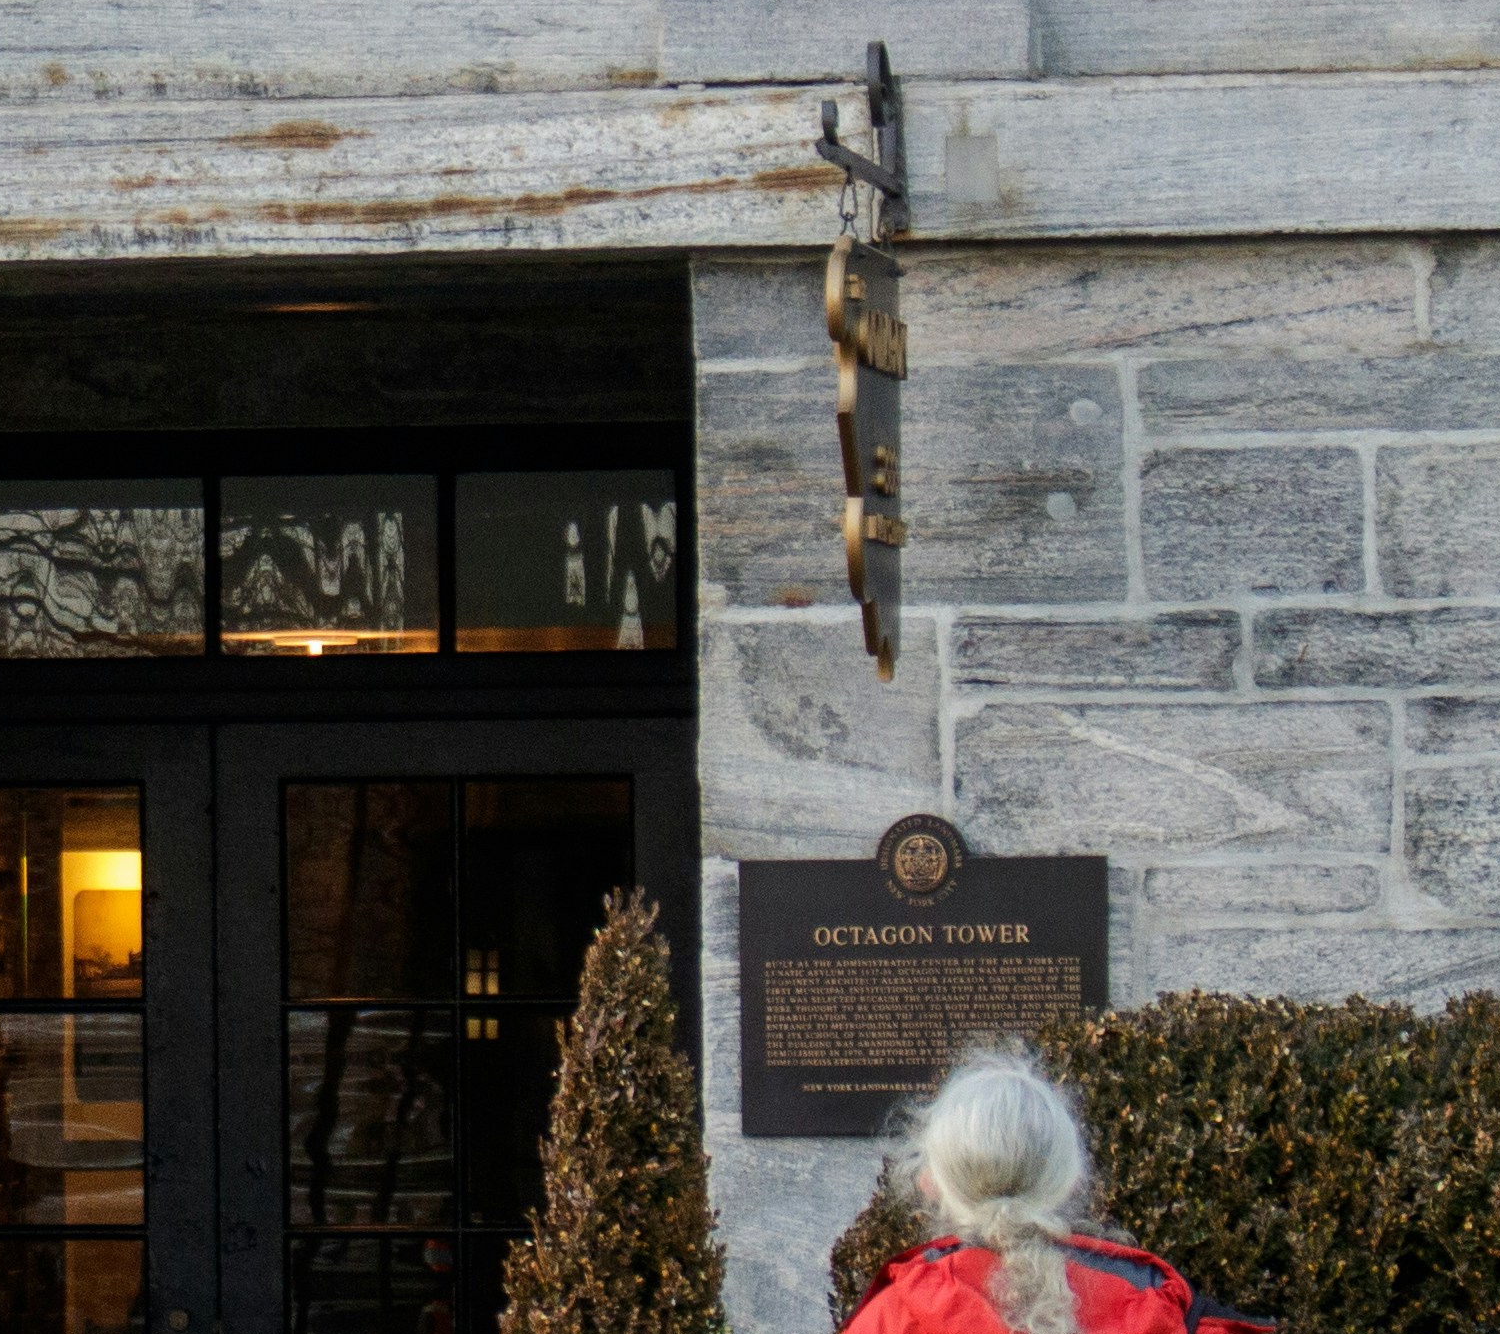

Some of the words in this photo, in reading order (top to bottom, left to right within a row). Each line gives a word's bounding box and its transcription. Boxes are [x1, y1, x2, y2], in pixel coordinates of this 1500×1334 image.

[814, 925, 934, 947] OCTAGON
[943, 923, 1031, 945] TOWER
[813, 959, 832, 968] THE
[836, 959, 917, 968] ADMINISTRATIVE
[922, 958, 959, 967] CENTER
[963, 958, 976, 966] OF
[980, 958, 998, 966] THE
[1002, 957, 1023, 966] NEW
[1027, 957, 1054, 966] YORK
[1057, 957, 1081, 965] CITY
[807, 968, 845, 977] ASYLUM
[847, 968, 857, 976] IN
[897, 967, 941, 976] OCTAGON
[944, 967, 975, 975] TOWER
[978, 967, 997, 975] WAS
[999, 966, 1046, 975] DESIGNED
[1063, 966, 1081, 974] THE
[824, 977, 878, 985] ARCHITECT
[881, 976, 938, 985] ALEXANDER
[942, 976, 985, 984] JACKSON
[1046, 975, 1058, 983] OF
[1063, 975, 1081, 983] THE
[765, 987, 791, 995] FIRST
[795, 986, 845, 995] MUNICIPAL
[849, 985, 914, 995] INSTITUTIONS
[917, 985, 928, 994] OF
[933, 985, 948, 994] ITS
[951, 985, 973, 994] TYPE
[978, 985, 989, 993] IN
[993, 985, 1010, 993] THE
[1063, 984, 1081, 992] THE
[789, 995, 808, 1004] WAS
[811, 995, 857, 1004] SELECTED
[859, 994, 900, 1003] BECAUSE
[904, 994, 921, 1003] THE
[925, 994, 971, 1003] PLEASANT
[1011, 993, 1081, 1002] SURROUNDINGS
[796, 1004, 838, 1013] THOUGHT
[841, 1004, 854, 1012] TO
[857, 1004, 869, 1012] BE
[872, 1003, 925, 1012] CONDUCIVE
[930, 1003, 942, 1012] TO
[945, 1003, 970, 1011] BOTH
[973, 1003, 1017, 1011] PHYSICAL
[1021, 1002, 1042, 1011] AND
[1044, 1002, 1081, 1011] MENTAL
[854, 1012, 892, 1021] DURING
[896, 1012, 913, 1021] THE
[948, 1012, 966, 1020] THE
[969, 1011, 1017, 1020] BUILDING
[766, 1022, 813, 1031] ENTRANCE
[817, 1022, 828, 1030] TO
[831, 1021, 898, 1030] METROPOLITAN
[959, 1020, 999, 1029] GENERAL
[805, 1030, 839, 1039] SCHOOL
[843, 1030, 854, 1039] OF
[859, 1030, 898, 1038] NURSING
[903, 1029, 921, 1038] AND
[788, 1039, 832, 1048] BUILDING
[836, 1039, 854, 1048] WAS
[858, 1039, 914, 1048] ABANDONED
[766, 1049, 827, 1057] DEMOLISHED
[829, 1049, 840, 1057] IN
[868, 1048, 917, 1057] RESTORED
[800, 1058, 832, 1067] GNEISS
[834, 1058, 885, 1066] STRUCTURE
[887, 1058, 895, 1066] IS
[802, 1083, 823, 1092] NEW
[827, 1083, 852, 1092] YORK
[855, 1082, 914, 1092] LANDMARKS
